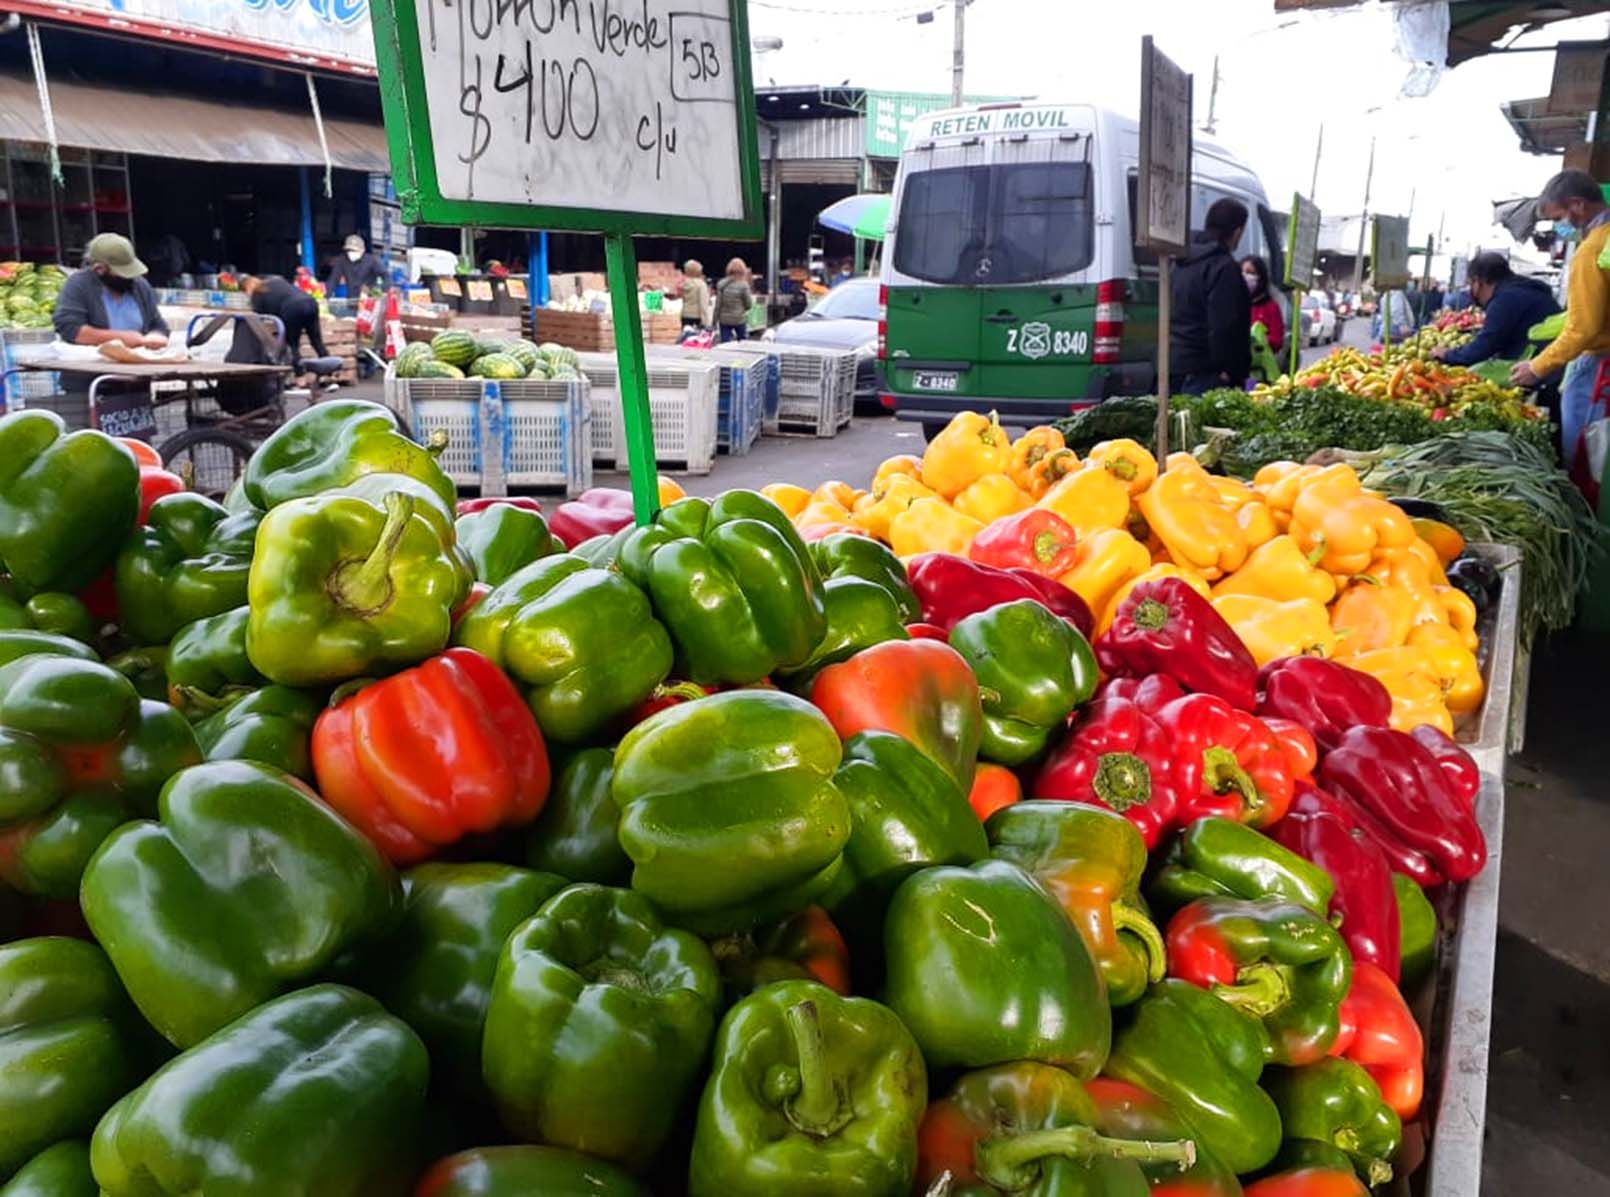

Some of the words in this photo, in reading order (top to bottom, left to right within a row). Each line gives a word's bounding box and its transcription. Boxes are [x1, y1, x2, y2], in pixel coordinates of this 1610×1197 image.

[930, 114, 991, 137] RETEN
[1003, 110, 1069, 130] MOVIL
[1006, 329, 1018, 352] Z
[1053, 331, 1088, 355] 8340
